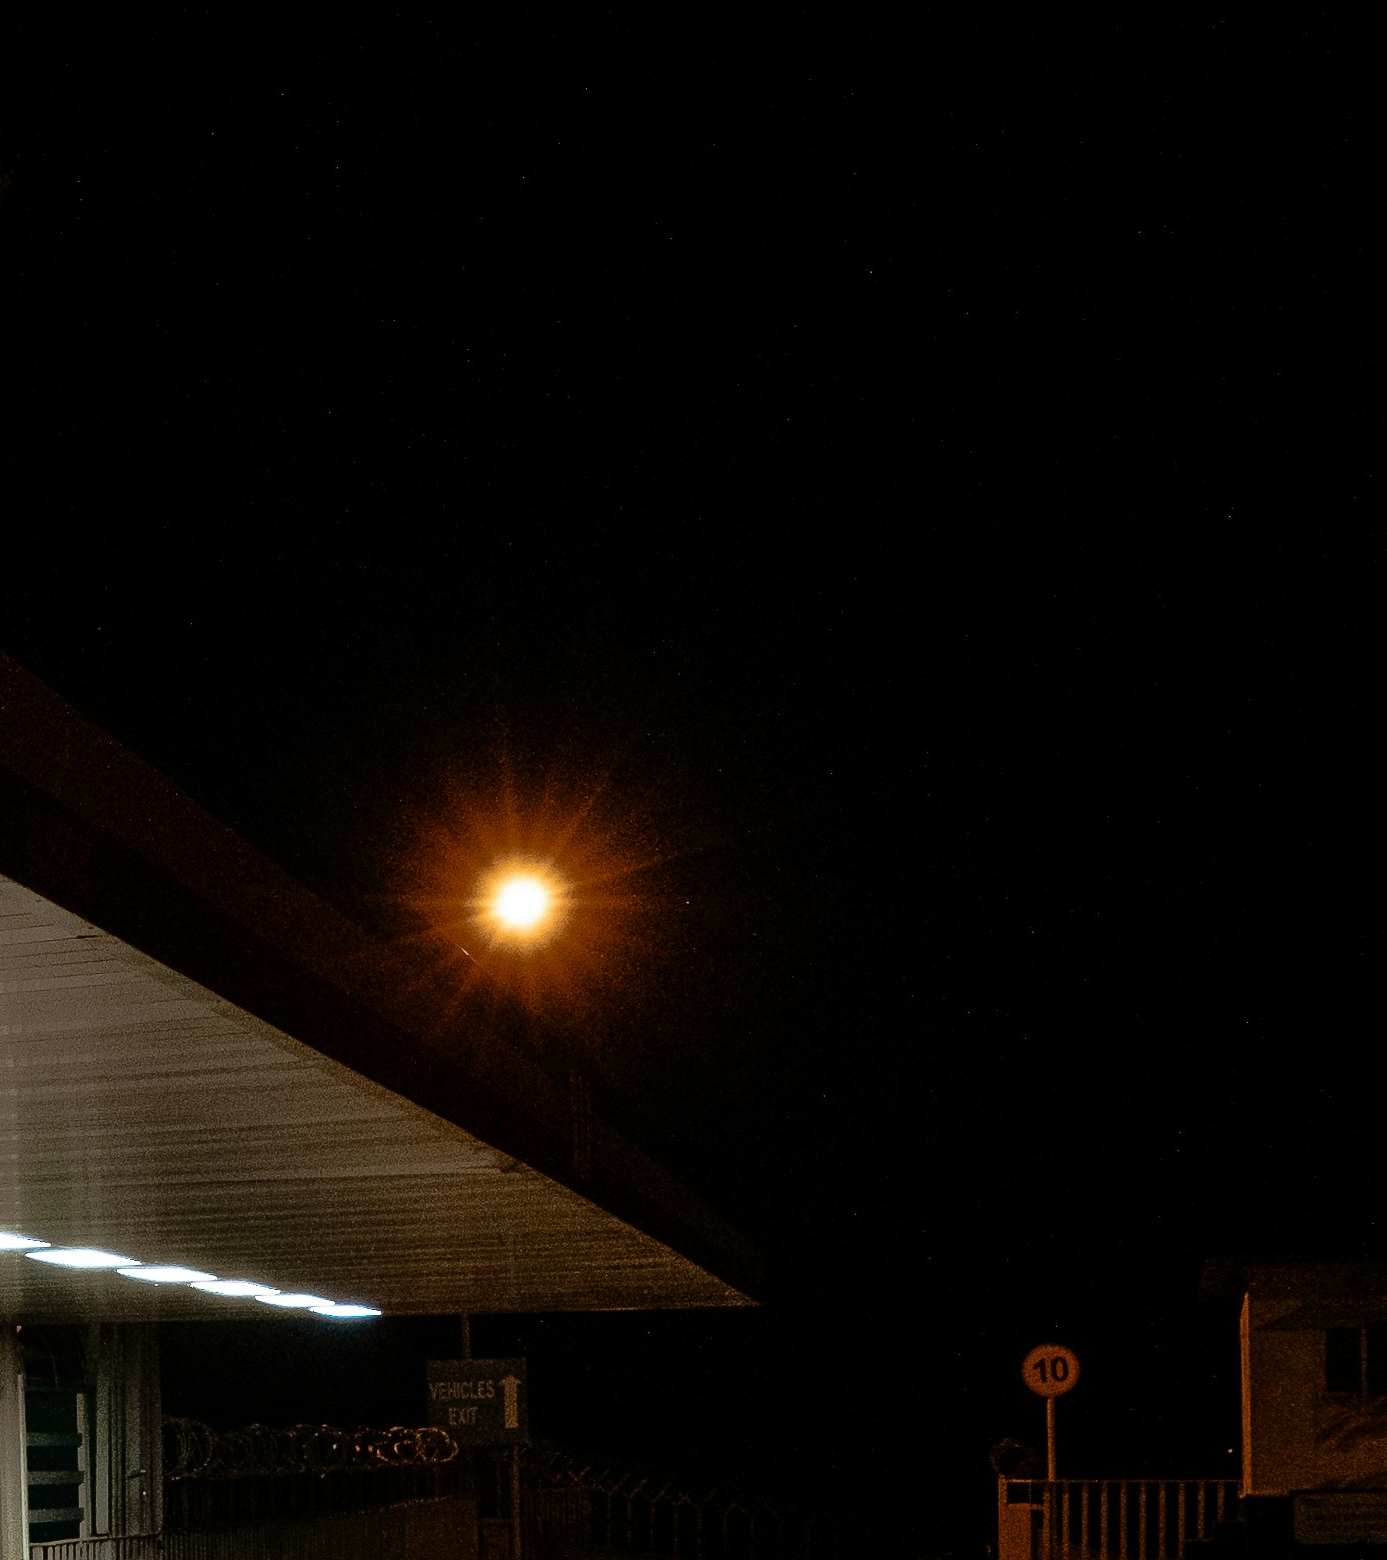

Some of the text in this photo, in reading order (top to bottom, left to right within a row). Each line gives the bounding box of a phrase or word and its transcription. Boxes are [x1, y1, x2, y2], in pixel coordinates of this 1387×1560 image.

[1033, 1356, 1069, 1384] 10
[429, 1380, 495, 1400] VEHICLES
[448, 1406, 478, 1425] EXIT
